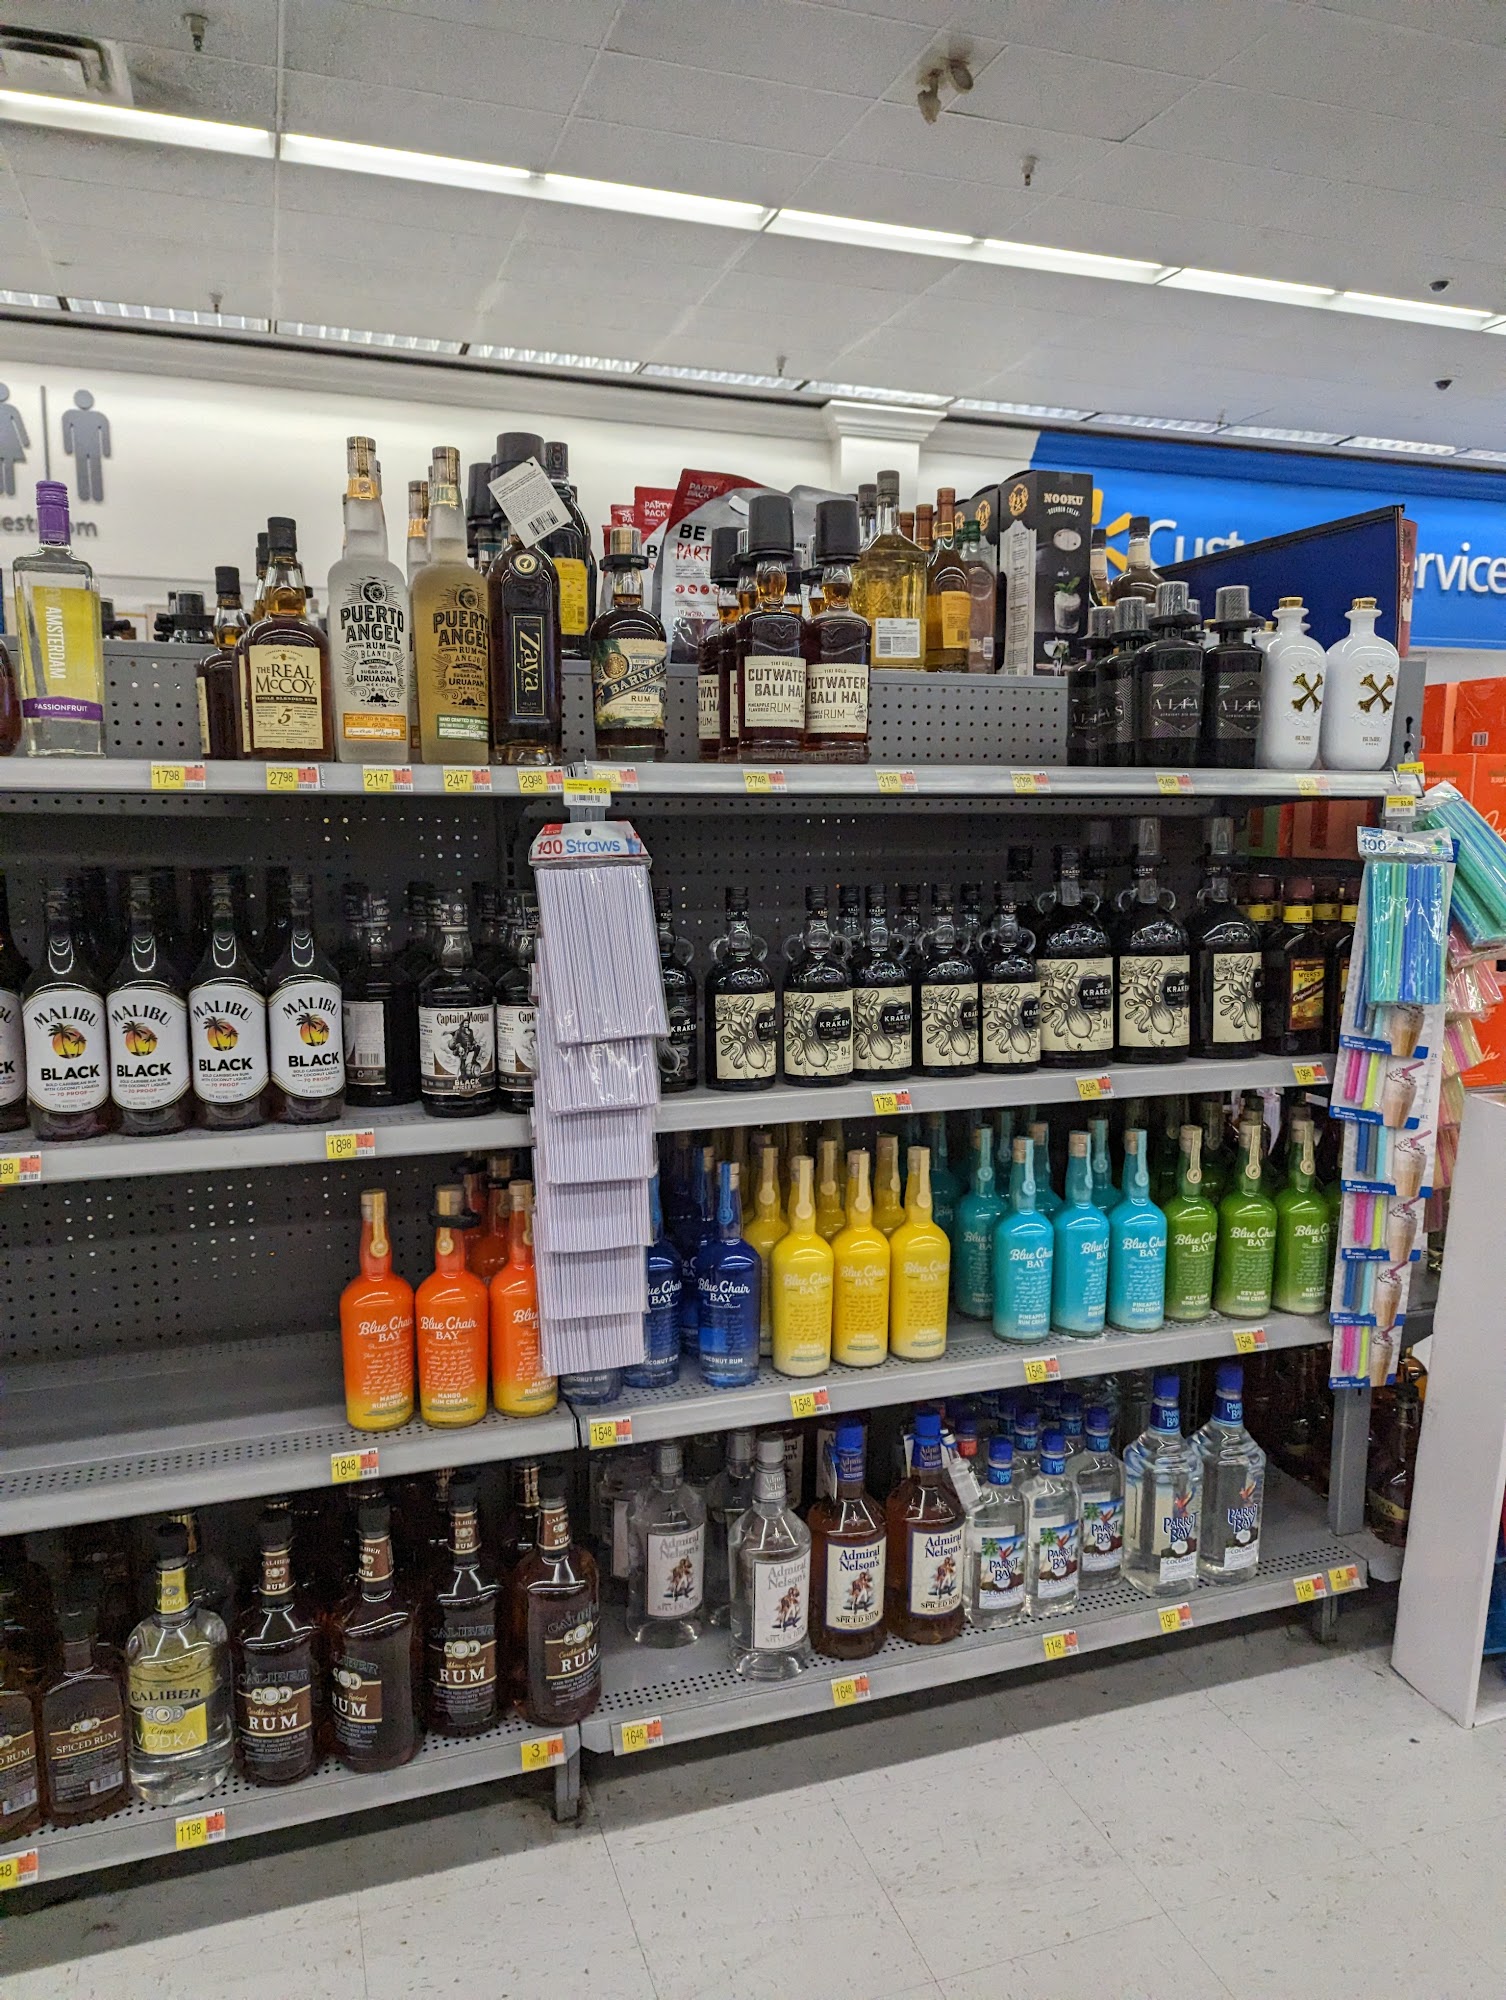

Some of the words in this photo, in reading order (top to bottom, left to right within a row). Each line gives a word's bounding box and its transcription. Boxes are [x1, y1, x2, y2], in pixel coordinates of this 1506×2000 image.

[644, 501, 673, 510] PARTY
[1043, 493, 1084, 506] NOOKU
[644, 509, 666, 517] PACK
[679, 524, 707, 541] BE
[676, 543, 711, 562] PART
[1414, 541, 1506, 594] rvice
[340, 605, 404, 632] PUERTO
[346, 624, 401, 644] ANGEL
[45, 606, 67, 680] AMSTERDAM
[366, 642, 386, 650] RUM
[361, 650, 391, 659] BLANCO
[517, 631, 541, 695] Zaya
[271, 664, 314, 679] REAL
[356, 675, 397, 683] URUAPAN
[449, 678, 484, 687] URUAPAN
[755, 684, 783, 696] BALI
[788, 685, 803, 698] HAI
[811, 691, 837, 704] BALI
[842, 691, 861, 704] HAI
[631, 695, 651, 703] RUM
[34, 703, 88, 712] PASSIONFRUIT
[770, 703, 791, 713] RUM
[823, 709, 845, 719] RUM
[277, 708, 293, 725] 5
[537, 840, 562, 854] 100
[566, 839, 620, 854] Straws
[1361, 838, 1386, 851] 100
[193, 1000, 253, 1022] MALIBU
[282, 997, 338, 1019] MALIBU
[33, 1006, 99, 1030] MALIBU
[111, 1004, 172, 1027] MALIBU
[437, 1012, 464, 1026] Captain
[467, 1011, 490, 1024] Morgan
[671, 1023, 697, 1032] KRAKEN
[819, 1019, 850, 1028] KRAKEN
[199, 1057, 253, 1072] BLACK
[288, 1052, 340, 1067] BLACK
[41, 1064, 100, 1081] BLACK
[117, 1062, 172, 1077] BLACK
[1230, 1227, 1256, 1239] Blue
[1294, 1225, 1319, 1237] Blue
[1122, 1238, 1148, 1250] Blue
[1174, 1234, 1201, 1246] Blue
[1247, 1239, 1267, 1247] BAY
[1010, 1249, 1035, 1261] Blue
[1080, 1242, 1103, 1255] Blue
[1140, 1249, 1159, 1257] BAY
[1192, 1244, 1210, 1252] BAY
[904, 1262, 929, 1273] Blue
[1026, 1260, 1045, 1268] BAY
[841, 1266, 863, 1277] Blue
[698, 1278, 718, 1292] Blue
[719, 1280, 750, 1294] Chair
[783, 1274, 808, 1286] Blue
[651, 1294, 673, 1304] BAY
[709, 1293, 733, 1303] BAY
[420, 1316, 445, 1330] Blue
[446, 1316, 477, 1329] Chair
[1018, 1312, 1046, 1320] PINEAPPLE
[358, 1322, 387, 1336] Blue
[435, 1330, 459, 1340] BAY
[378, 1332, 401, 1343] BAY
[372, 1401, 386, 1409] RUM
[446, 1397, 468, 1405] CREAM
[1091, 1520, 1119, 1537] PARROT
[1163, 1511, 1199, 1535] PARROT
[1233, 1518, 1255, 1534] BAY
[660, 1531, 700, 1549] Admiral
[925, 1530, 962, 1549] Admiral
[1096, 1531, 1115, 1545] BAY
[1170, 1526, 1193, 1543] BAY
[660, 1545, 699, 1561] Nelson's
[839, 1546, 880, 1561] Admiral
[925, 1543, 962, 1559] Nelson's
[1047, 1544, 1074, 1562] PARROT
[839, 1556, 880, 1571] Nelson's
[989, 1557, 1019, 1573] PARROT
[1052, 1556, 1070, 1570] BAY
[1166, 1555, 1194, 1565] COCONUT
[768, 1560, 807, 1580] Admiral
[994, 1569, 1014, 1582] BAY
[768, 1574, 807, 1590] Nelson's
[921, 1600, 948, 1609] SPICED
[835, 1615, 865, 1624] SPICED
[561, 1642, 597, 1673] RUM
[440, 1666, 485, 1683] RUM
[131, 1688, 201, 1701] CALIBER
[249, 1713, 298, 1731] RUM
[56, 1736, 93, 1755] SPICED
[94, 1731, 117, 1745] RUM
[135, 1732, 199, 1748] VODKA
[7, 1748, 30, 1763] RUM
